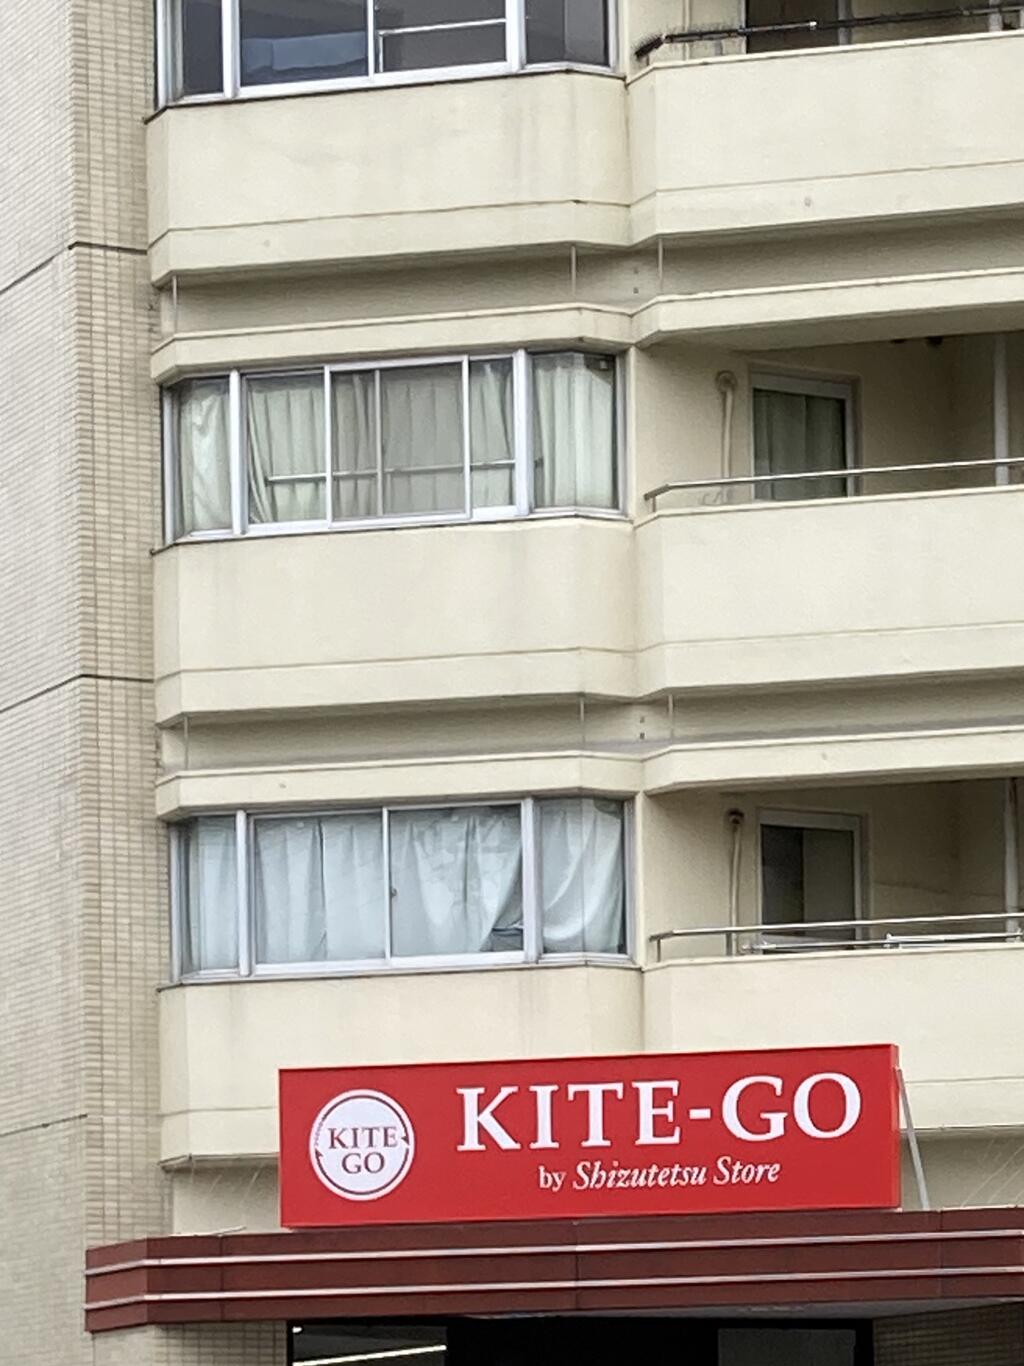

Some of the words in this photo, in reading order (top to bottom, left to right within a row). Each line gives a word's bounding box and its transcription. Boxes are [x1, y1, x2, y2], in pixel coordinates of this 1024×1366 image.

[456, 1071, 863, 1153] KITE-GO
[327, 1124, 398, 1150] KITE
[341, 1149, 386, 1176] GO
[538, 1164, 567, 1192] by
[572, 1158, 708, 1190] Shizutetsu
[713, 1155, 781, 1186] Store
